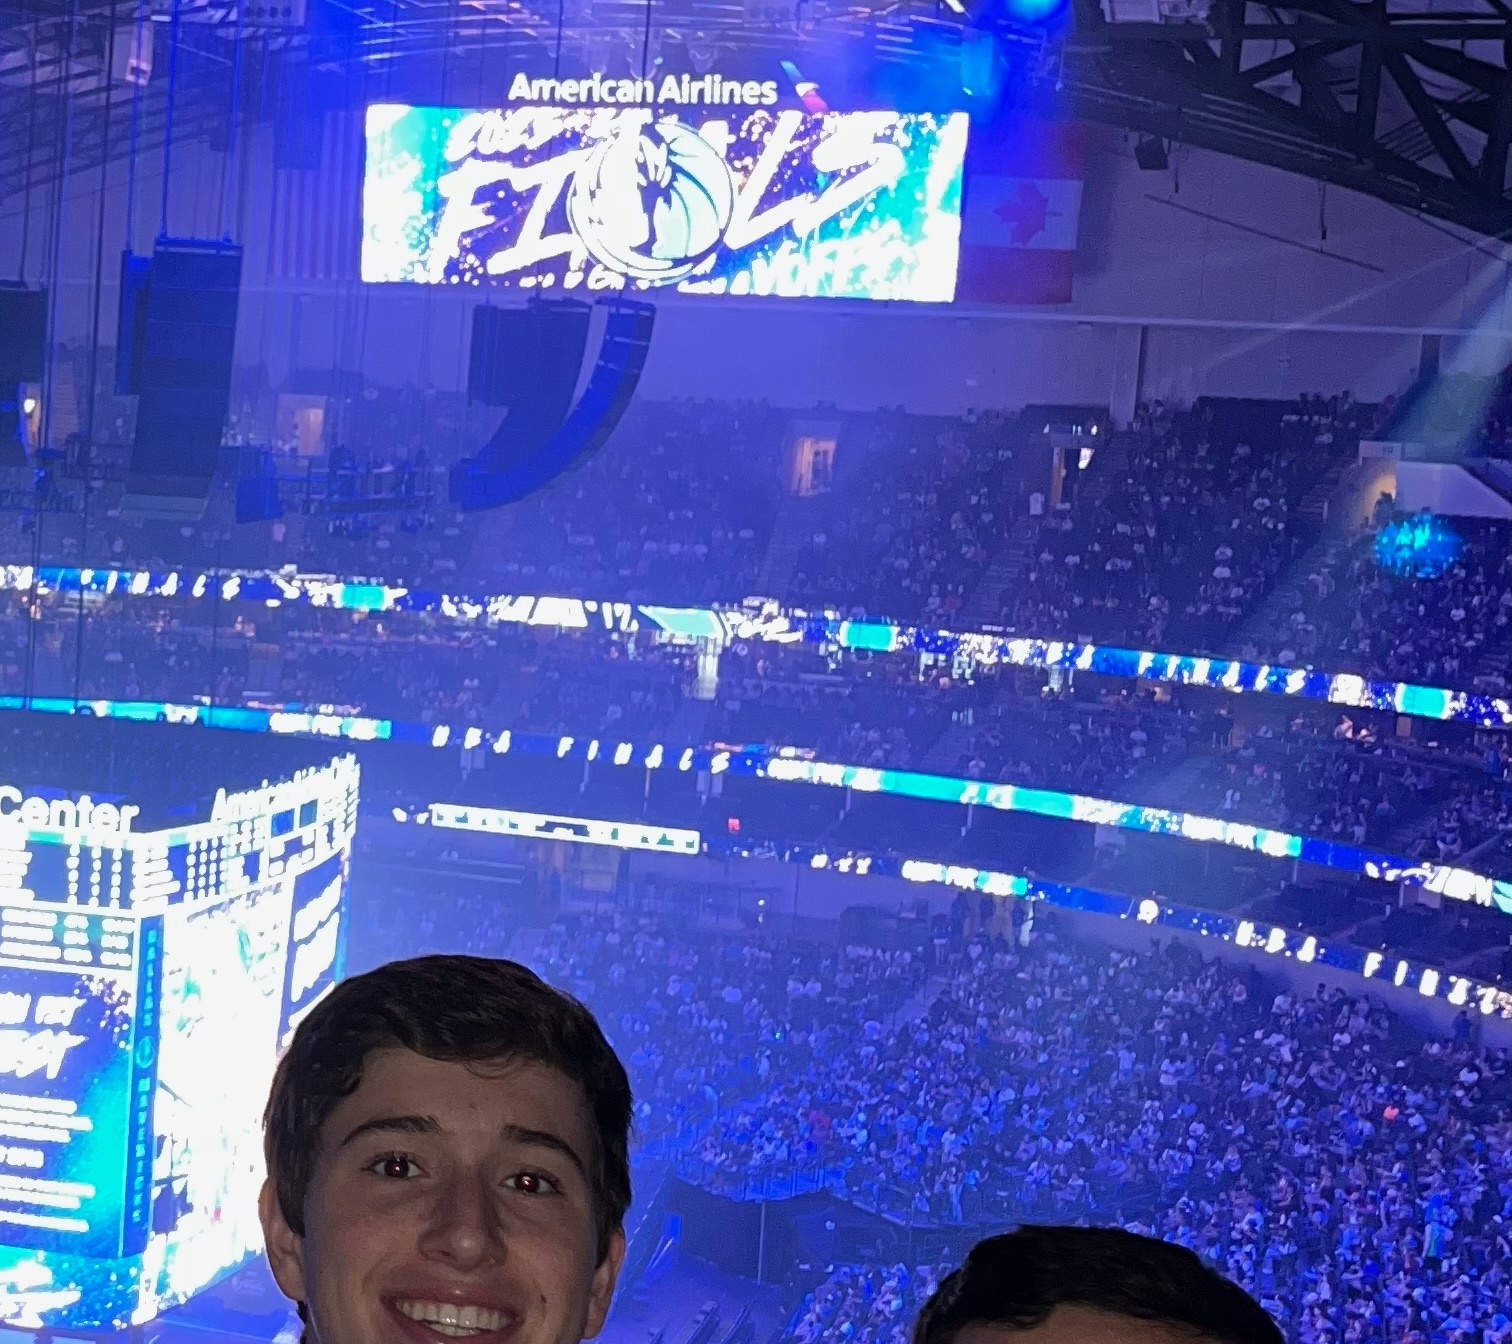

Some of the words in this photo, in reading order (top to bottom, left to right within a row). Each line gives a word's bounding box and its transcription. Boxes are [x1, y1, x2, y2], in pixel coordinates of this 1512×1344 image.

[508, 72, 654, 104] American
[657, 73, 778, 105] Airlines
[556, 736, 731, 774] FINALS
